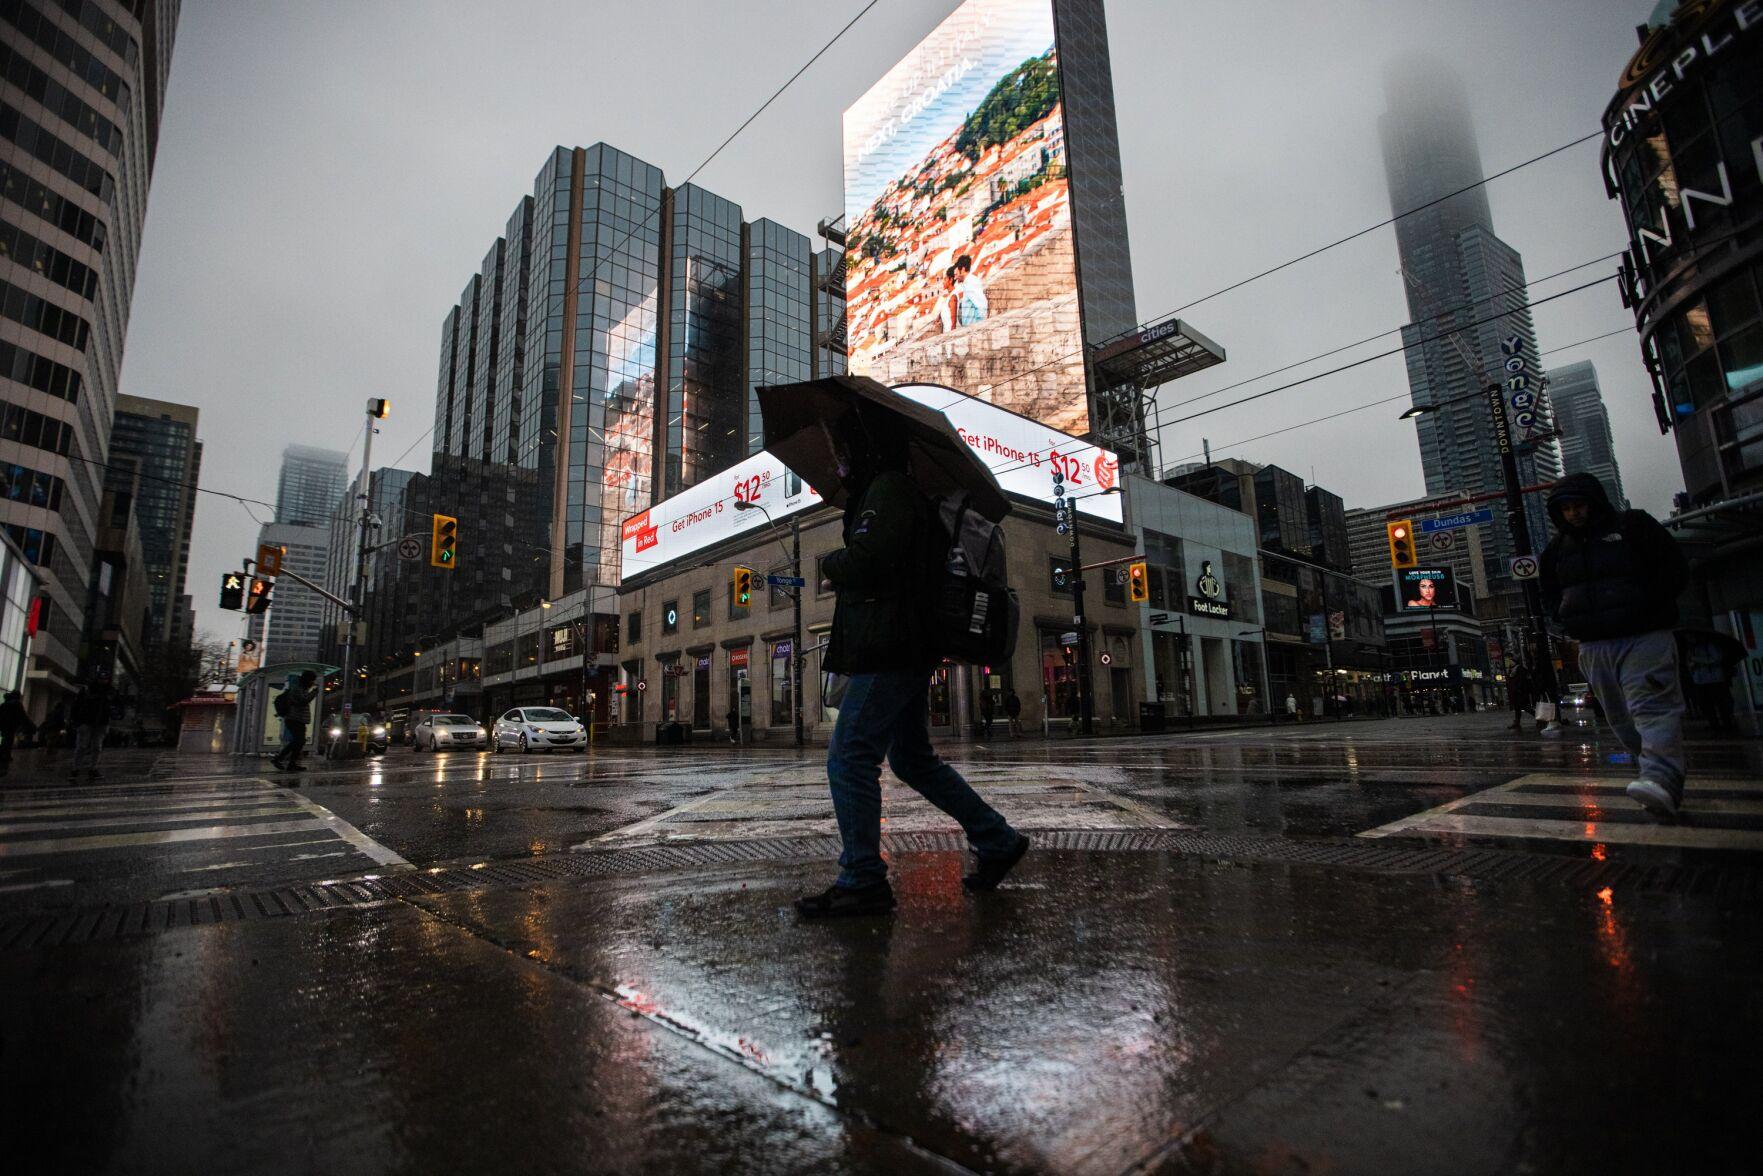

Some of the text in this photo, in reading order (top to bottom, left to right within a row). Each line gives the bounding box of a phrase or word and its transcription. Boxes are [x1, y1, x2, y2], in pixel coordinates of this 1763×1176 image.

[1141, 323, 1175, 343] cities
[1502, 336, 1535, 428] Yonge
[1490, 389, 1509, 455] DOWNTOWN
[956, 428, 1041, 467] Get iPhone 15
[762, 470, 771, 482] 50
[625, 515, 648, 534] Wrapped
[672, 520, 685, 533] Get
[686, 508, 712, 526] iPhone
[714, 501, 724, 515] 15
[1434, 515, 1472, 528] Dundas
[638, 534, 655, 546] in Red
[1193, 600, 1229, 616] Foot Locker
[1411, 668, 1449, 680] Planet
